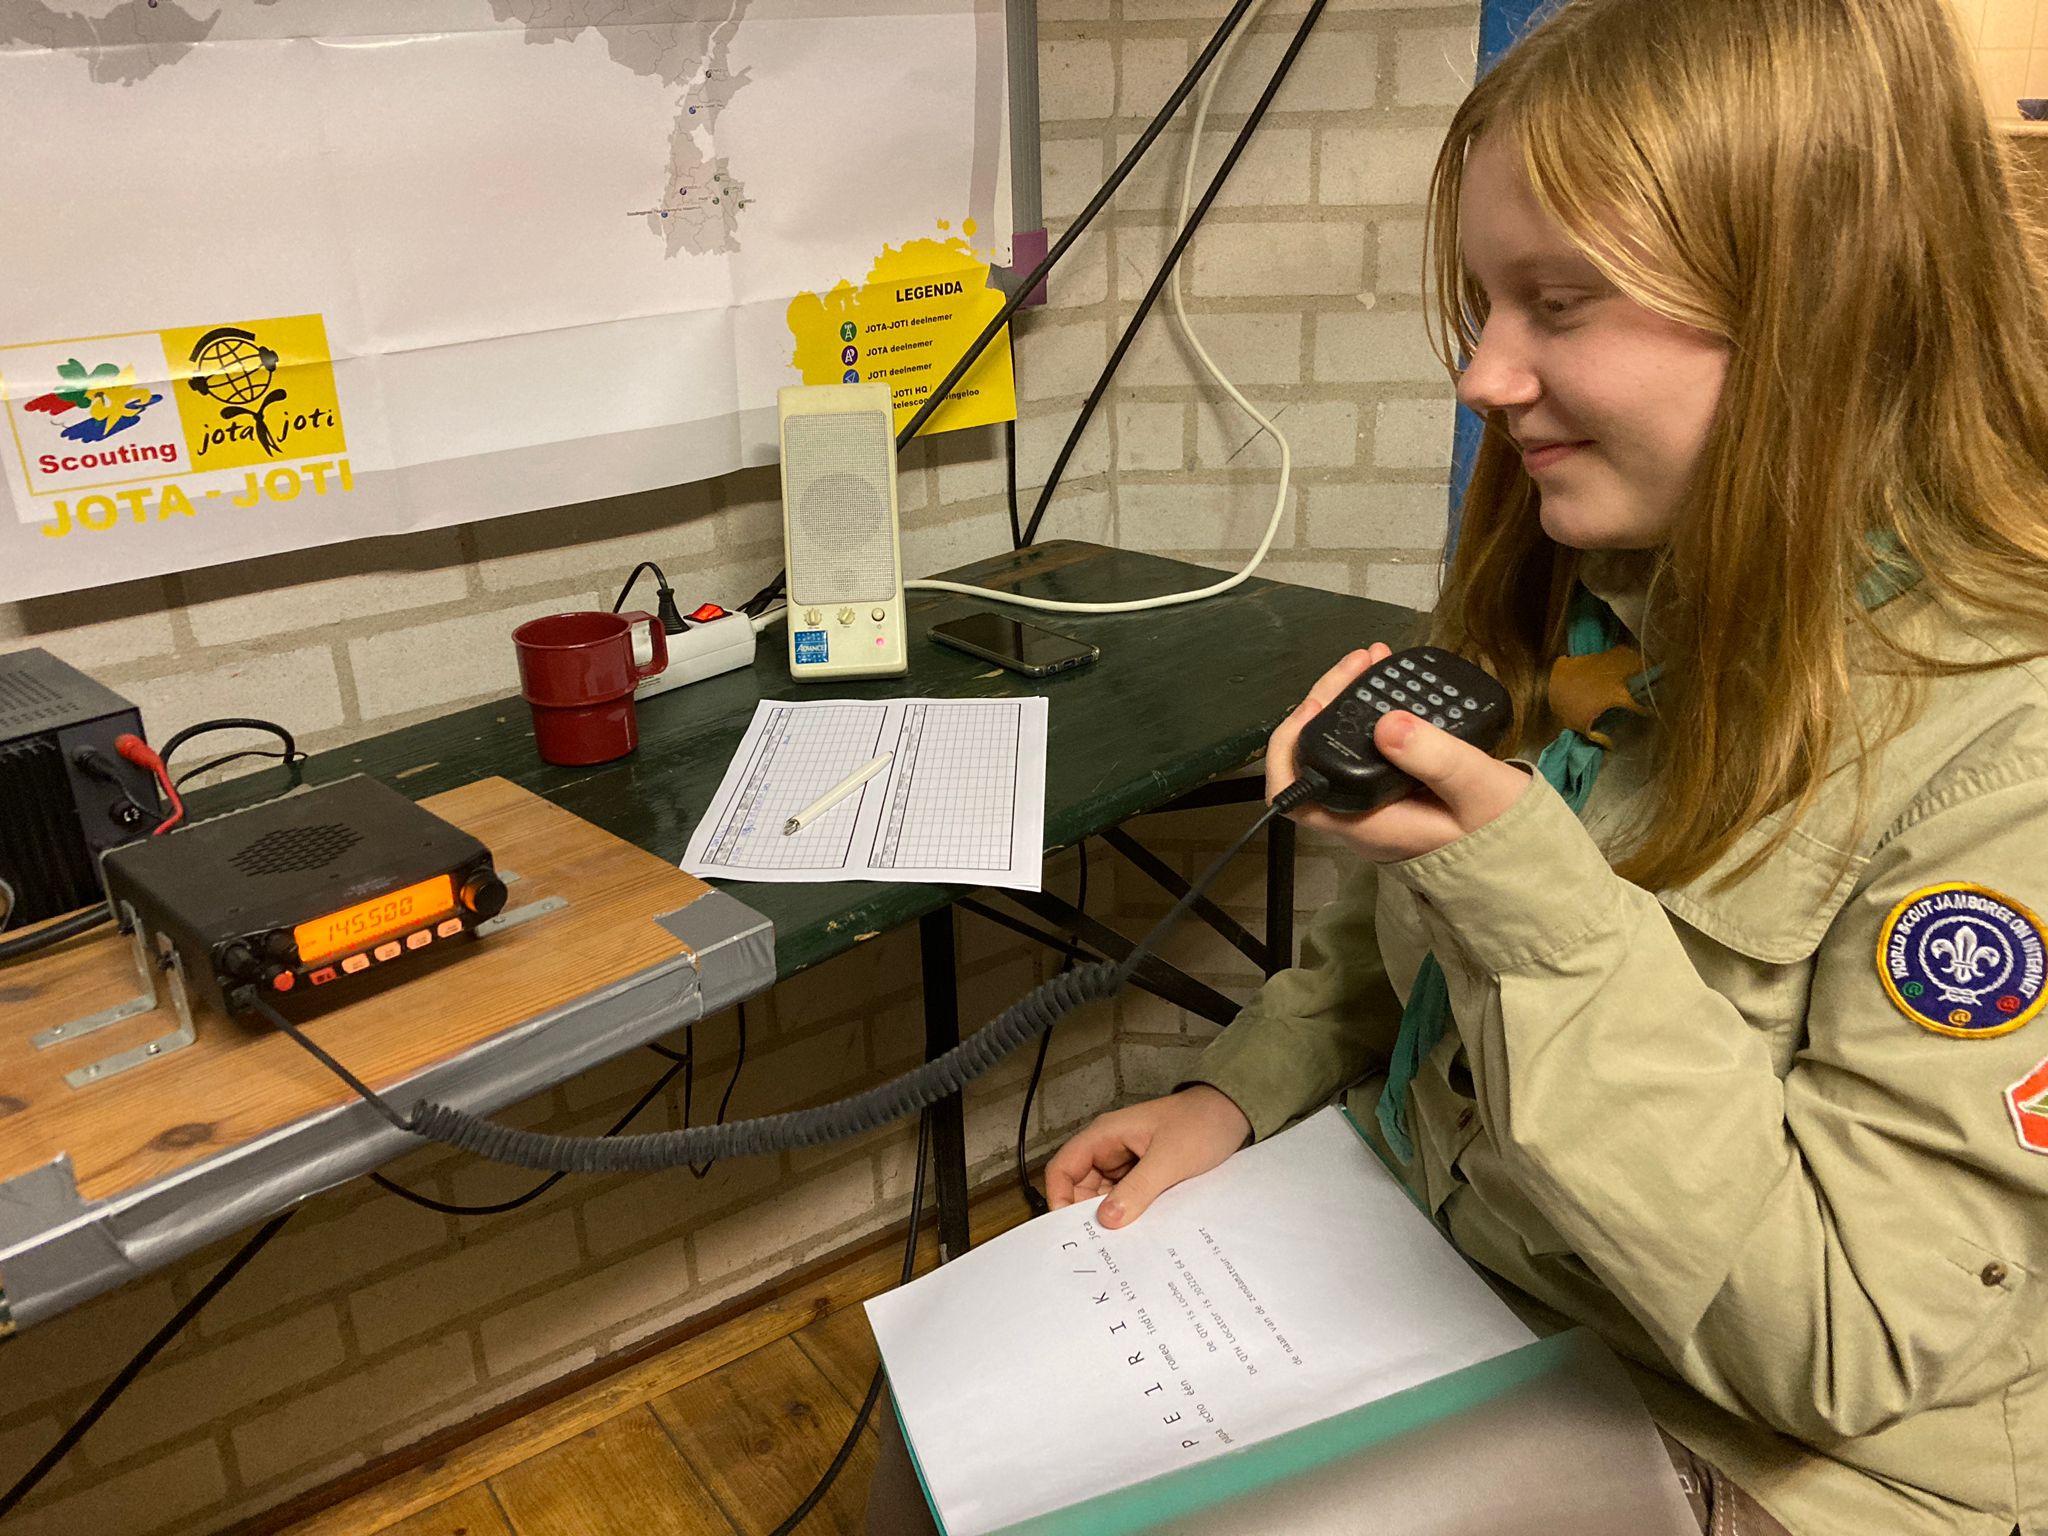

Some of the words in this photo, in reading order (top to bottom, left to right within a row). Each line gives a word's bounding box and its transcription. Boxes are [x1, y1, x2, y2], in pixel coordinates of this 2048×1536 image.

[896, 281, 963, 302] LEGENDA
[865, 319, 909, 333] JOTA-JOTI
[910, 313, 953, 326] deelnemer
[866, 346, 888, 357] JOTA
[890, 340, 933, 353] deelnemer
[867, 370, 887, 380] JOTI
[889, 363, 932, 376] deelnemer
[915, 386, 928, 395] HQ
[197, 420, 254, 456] jota
[276, 408, 335, 443] joti
[38, 442, 177, 475] Scouting
[40, 484, 197, 539] JOTA
[231, 459, 354, 508] JOTI
[1897, 900, 1934, 935] SCOUT
[1934, 893, 2016, 924] JAMBOREE
[2009, 919, 2033, 940] ON
[1890, 934, 1909, 980] WORLD
[1083, 1220, 1101, 1240] jota
[1212, 1245, 1222, 1255] is
[1219, 1257, 1257, 1303] zendamateur
[1120, 1280, 1137, 1303] kilo
[1186, 1309, 1197, 1320] is
[1254, 1304, 1265, 1316] de
[1137, 1307, 1157, 1335] india
[1211, 1311, 1236, 1344] Locator
[1263, 1316, 1277, 1333] van
[1275, 1334, 1293, 1354] naam
[1158, 1343, 1179, 1371] romeo
[1291, 1354, 1303, 1366] de
[1196, 1403, 1214, 1424] echo
